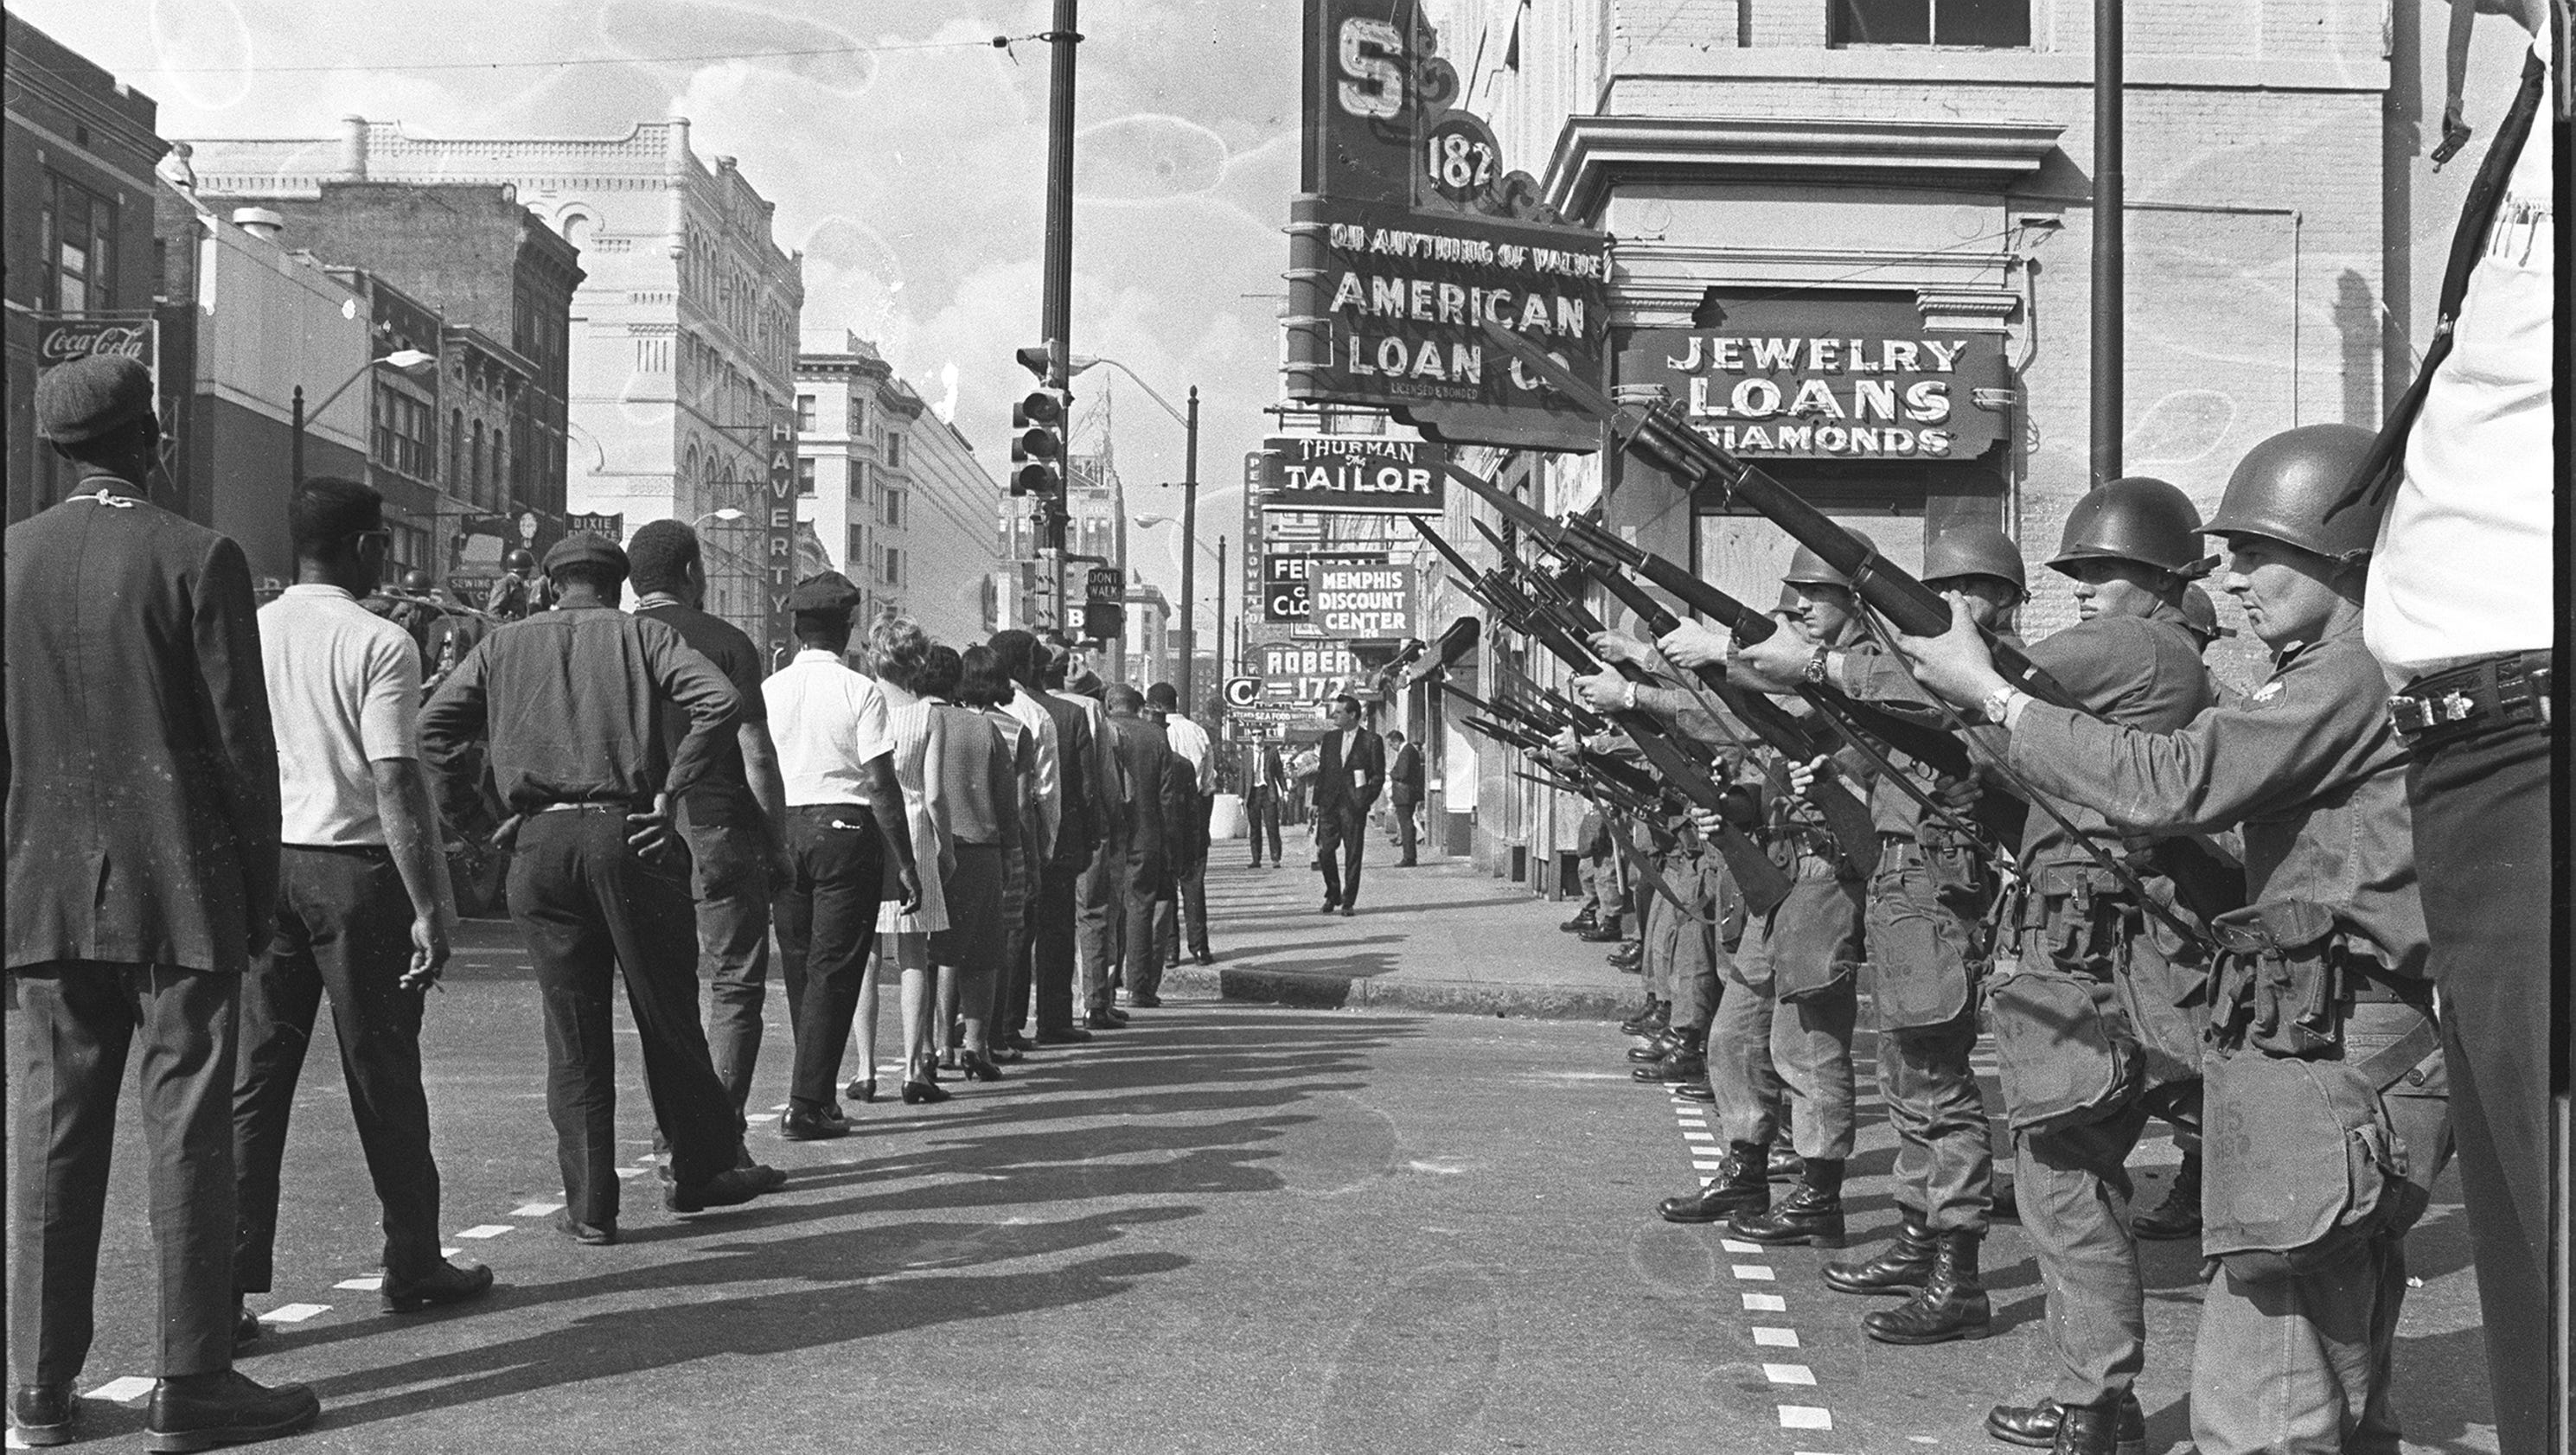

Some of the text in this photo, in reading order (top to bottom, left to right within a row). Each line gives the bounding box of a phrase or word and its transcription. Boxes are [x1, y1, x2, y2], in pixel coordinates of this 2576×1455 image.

[1338, 16, 1403, 120] S
[1429, 133, 1493, 188] 182
[1370, 228, 1493, 265] ANYTHING
[1498, 243, 1529, 270] OF
[1532, 247, 1602, 278] VALUE
[1329, 271, 1584, 339] AMERICAN
[1349, 334, 1481, 385] LOAN
[1667, 337, 1968, 372] JEWELRY
[1690, 377, 1951, 422] LOANS
[1299, 438, 1415, 464] THURMAN
[1284, 465, 1432, 495] TAILOR
[1318, 591, 1406, 610] DISCOUNT
[1322, 571, 1403, 590] MEMPHIS
[1325, 612, 1407, 630] CENTER
